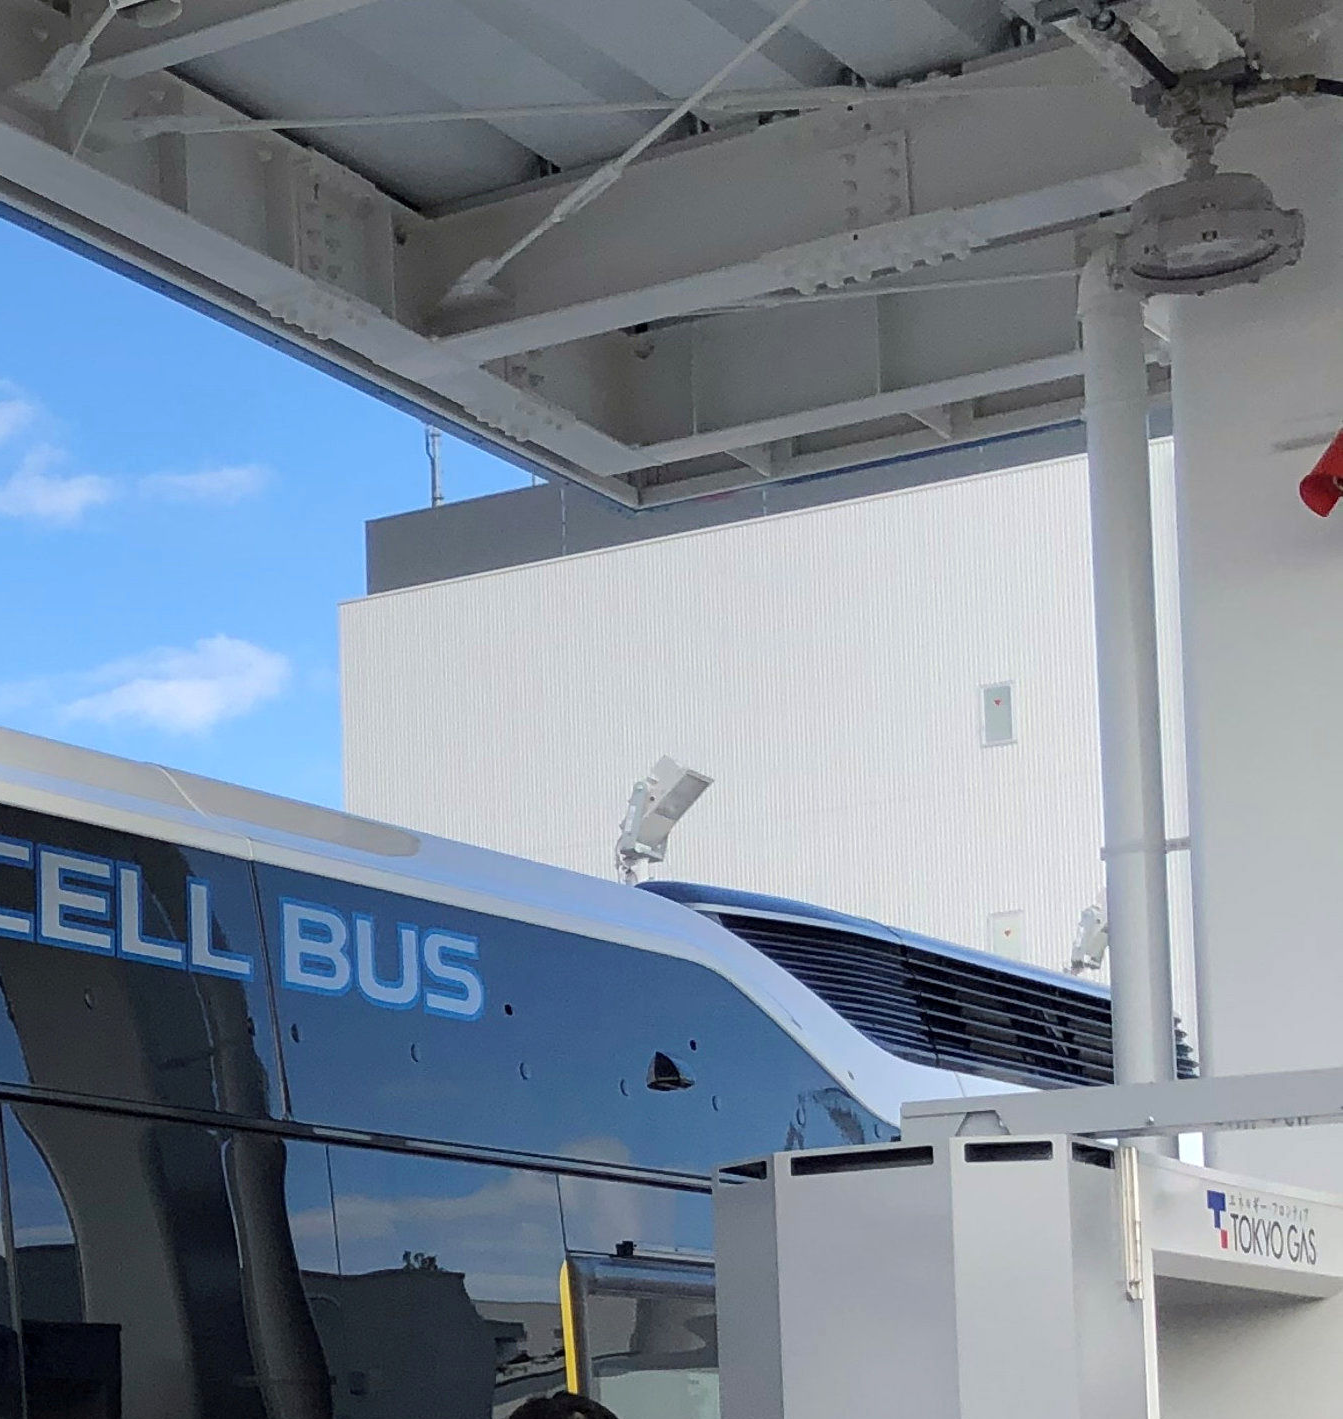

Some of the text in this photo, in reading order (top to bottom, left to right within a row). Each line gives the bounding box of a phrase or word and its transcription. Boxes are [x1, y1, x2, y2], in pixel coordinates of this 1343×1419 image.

[279, 895, 487, 1022] BUS
[1229, 1212, 1317, 1266] TOKYO GAS
